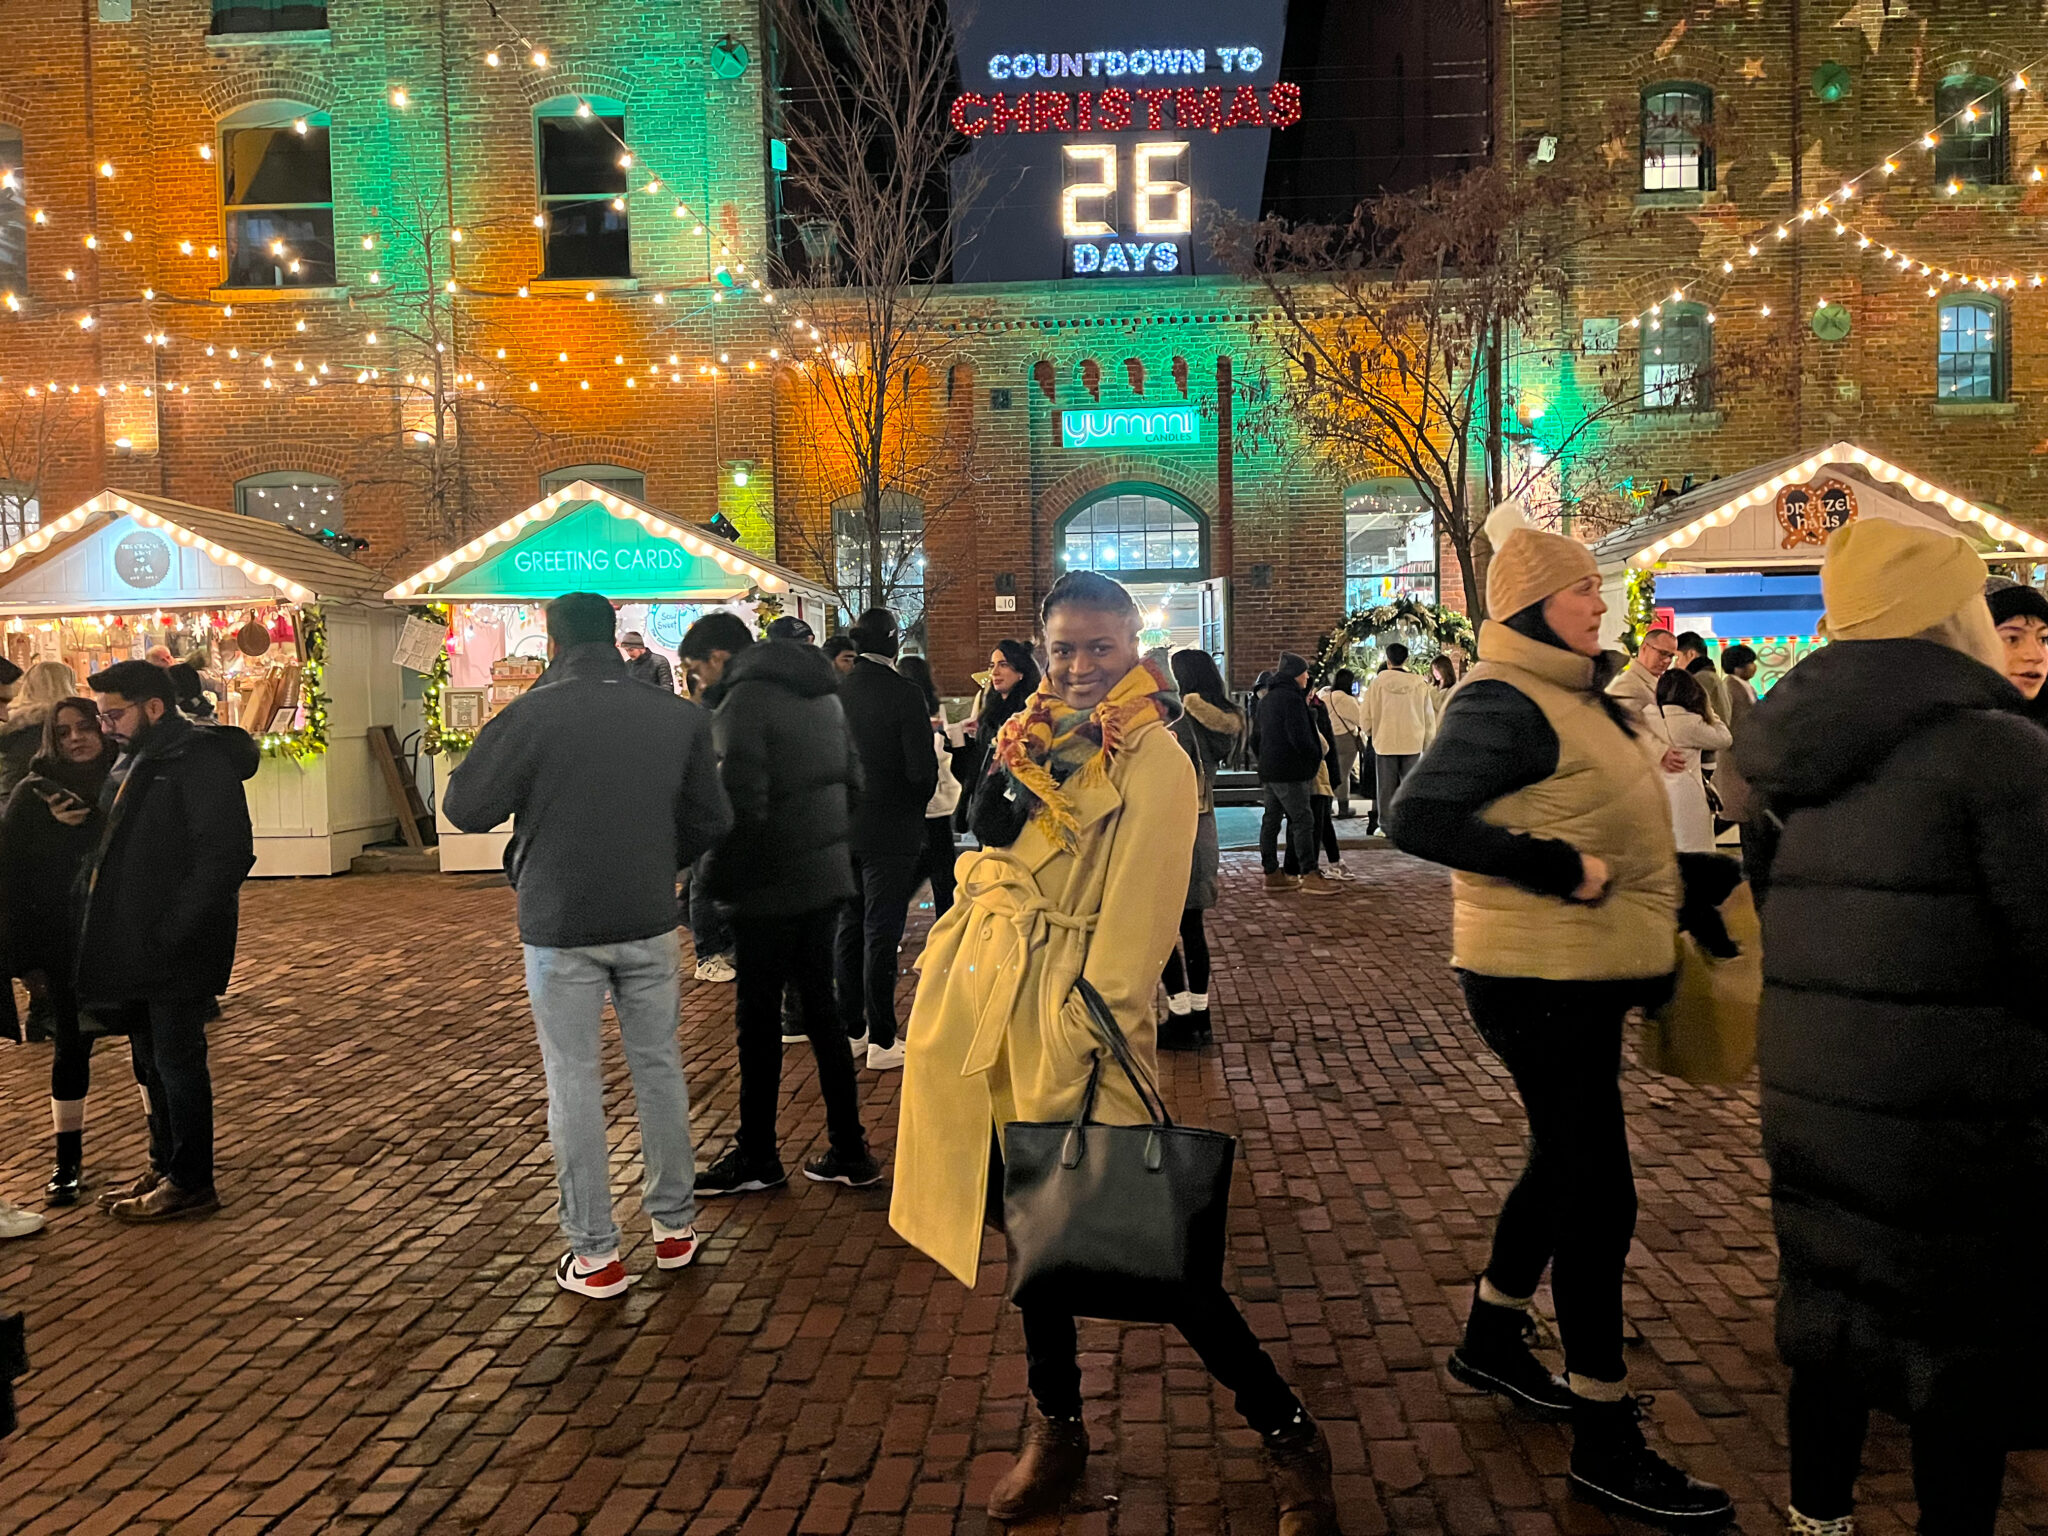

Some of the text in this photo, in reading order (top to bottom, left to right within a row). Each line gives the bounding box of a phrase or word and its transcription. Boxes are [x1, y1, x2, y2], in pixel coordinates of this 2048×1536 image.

[988, 46, 1263, 79] COUNTDOWN TO
[950, 82, 1302, 136] CHRISTMAS
[1063, 142, 1191, 236] 26
[1073, 241, 1179, 273] DAYS
[1065, 409, 1192, 446] yummi
[1145, 432, 1192, 443] CANDLES
[1796, 514, 1840, 530] haus
[514, 548, 683, 572] GREETING CARDS
